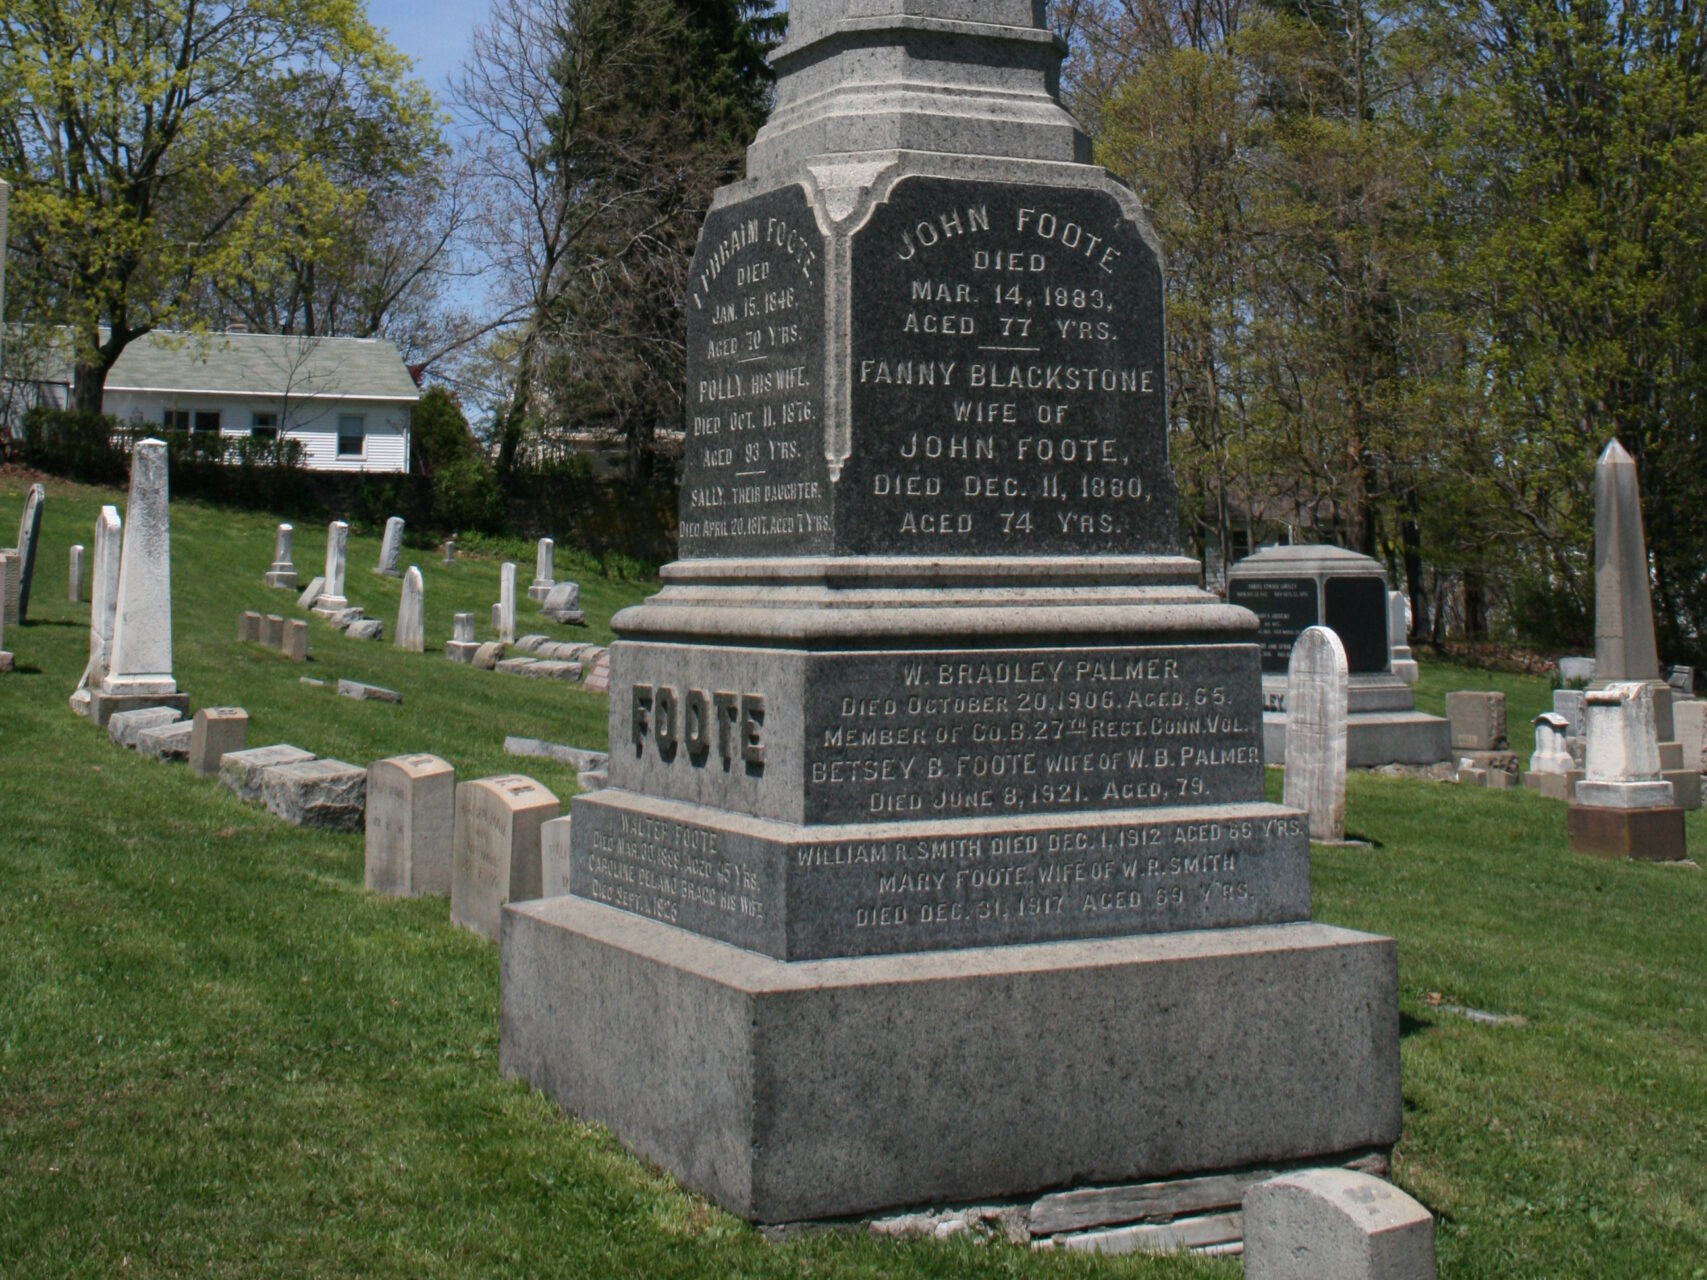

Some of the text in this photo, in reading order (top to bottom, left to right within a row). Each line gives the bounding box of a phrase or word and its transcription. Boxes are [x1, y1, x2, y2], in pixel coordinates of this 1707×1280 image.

[897, 204, 1122, 275] JOHN FOOTE
[737, 261, 770, 286] DIED
[974, 250, 1046, 272] DIED
[995, 283, 1033, 308] 14,
[712, 303, 738, 325] JAN.
[903, 313, 975, 335] AGED
[999, 317, 1032, 338] 77
[707, 337, 738, 360] AGED
[746, 329, 762, 351] 70
[751, 373, 772, 394] HIS
[860, 360, 1154, 393] FANNY BLACKSTONE
[693, 416, 721, 437] DIED
[730, 411, 756, 432] OCT.
[954, 401, 1070, 424] WIFE OF
[703, 447, 732, 468] AGED
[745, 442, 761, 464] 93
[900, 435, 1129, 464] JOHN FOOTE,
[732, 486, 761, 505] THEIR
[874, 474, 942, 497] DIED
[964, 475, 1027, 498] DEC.
[679, 520, 700, 538] DIED
[702, 519, 728, 537] APRIL
[770, 516, 794, 534] AGED
[899, 512, 973, 534] AGED
[1000, 513, 1034, 534] 74
[903, 658, 1180, 687] W. BRADLEY PALMER
[841, 696, 897, 717] DIED
[906, 694, 1008, 715] OCTOBER
[1055, 691, 1121, 711] 1906.
[1194, 687, 1232, 707] 65.
[632, 683, 766, 765] FOOTE
[823, 724, 927, 747] MEMBER
[936, 724, 963, 744] OF
[811, 759, 915, 784] BETSEY
[956, 754, 1037, 777] FOOTE
[1046, 752, 1095, 773] WIFE
[1098, 752, 1123, 771] OF
[1128, 749, 1151, 769] W.
[1180, 746, 1259, 766] PALMER
[871, 790, 923, 813] DIED
[933, 788, 994, 808] JUNE
[1004, 787, 1025, 808] 8,
[1031, 782, 1088, 805] 1921.
[1176, 778, 1210, 797] 79.
[593, 830, 613, 852] DIED
[684, 855, 713, 879] AGED
[675, 827, 718, 855] FOOTE
[798, 843, 887, 866] WILLIAM
[916, 838, 983, 860] SMITH
[990, 836, 1038, 856] DIED
[1048, 832, 1094, 852] DEC.
[1173, 825, 1221, 845] AGED
[588, 853, 635, 884] CAROLINE
[720, 890, 736, 912] HIS
[740, 896, 764, 920] WIFE
[878, 873, 946, 893] MARY
[1039, 865, 1086, 885] WIFE
[1089, 863, 1116, 883] OF
[1122, 861, 1145, 880] W.
[1170, 855, 1235, 876] SMITH
[592, 879, 612, 902] DIED
[856, 906, 907, 927] DIED
[920, 903, 971, 924] DEC.
[977, 901, 1008, 922] 31,
[1018, 898, 1064, 917] 1917
[1082, 892, 1140, 912] AGED
